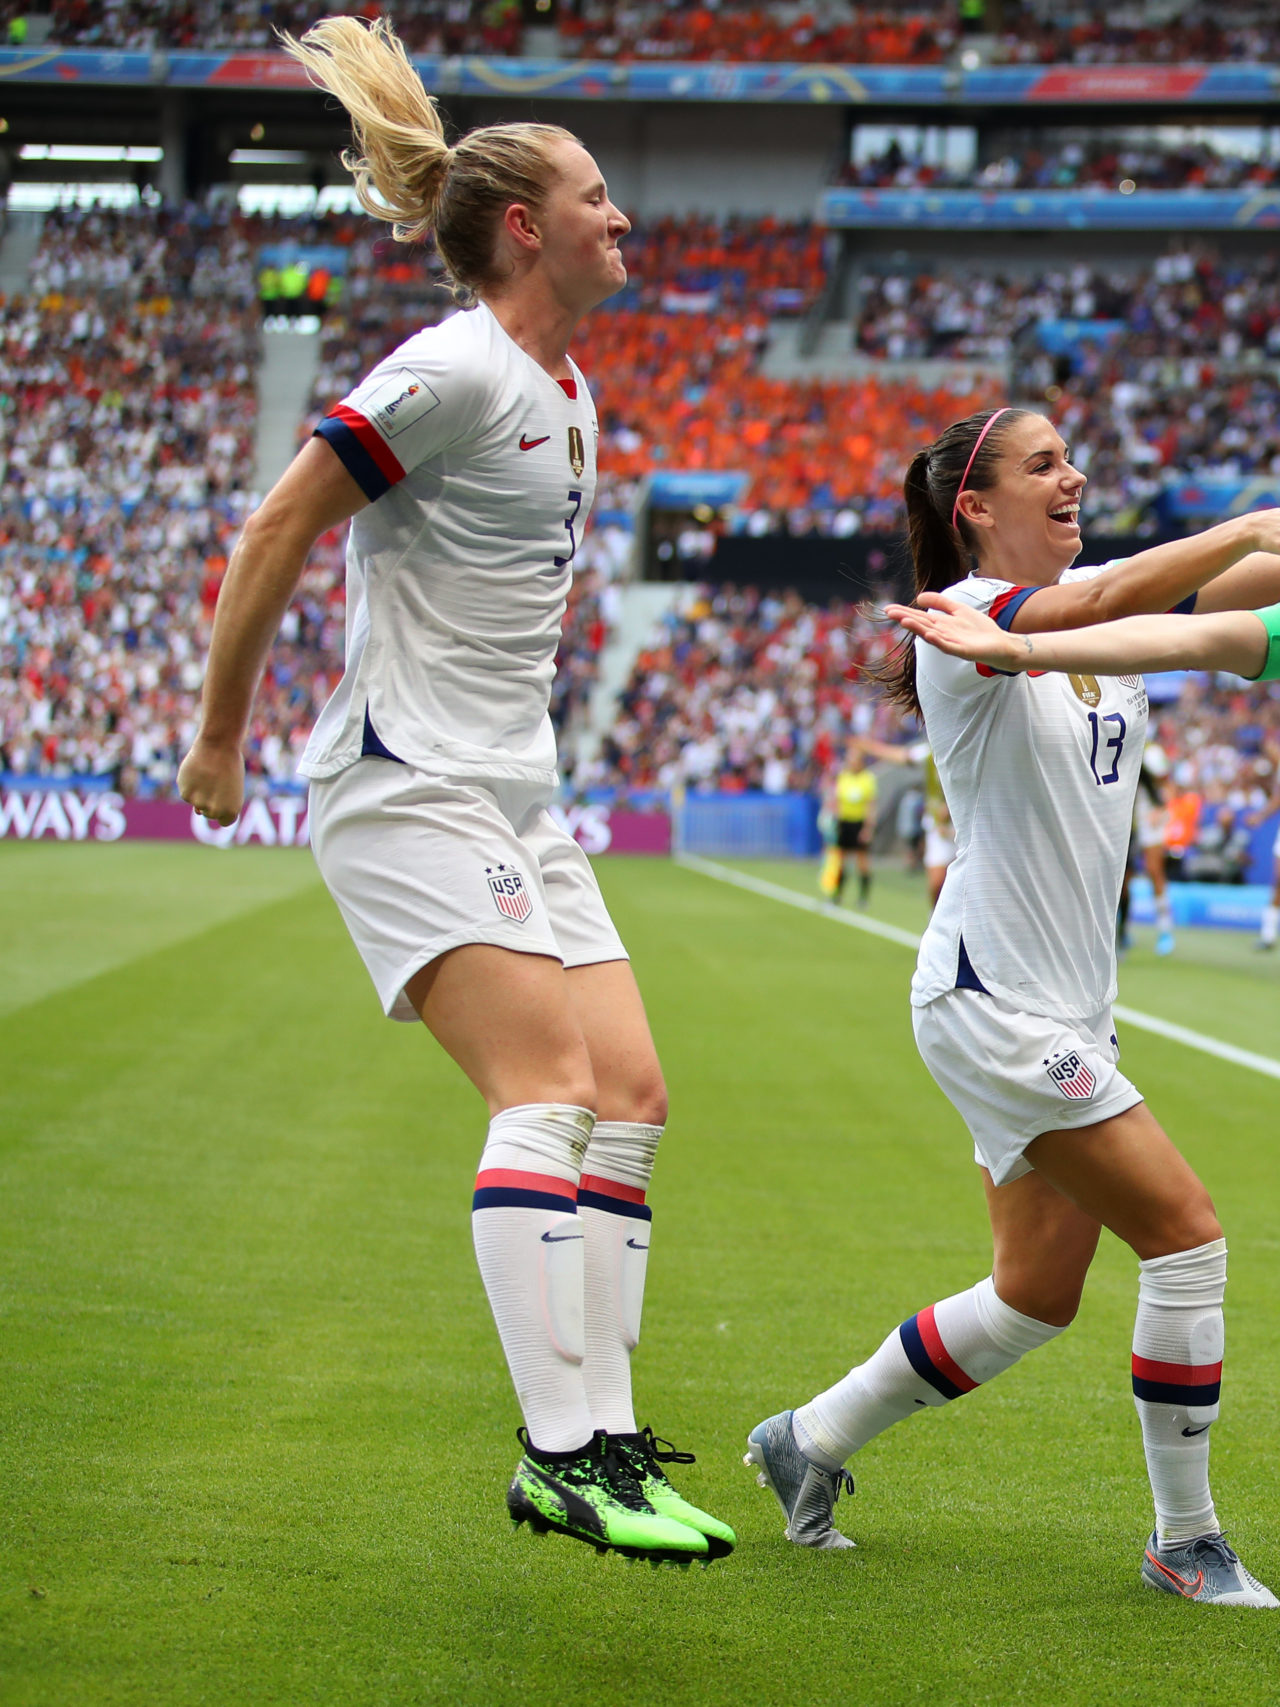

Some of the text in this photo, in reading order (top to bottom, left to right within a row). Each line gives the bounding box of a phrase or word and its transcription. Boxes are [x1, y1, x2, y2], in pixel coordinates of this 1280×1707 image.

[554, 491, 582, 567] 3
[1088, 712, 1126, 786] 13
[492, 877, 522, 896] USA
[1052, 1055, 1081, 1081] USA
